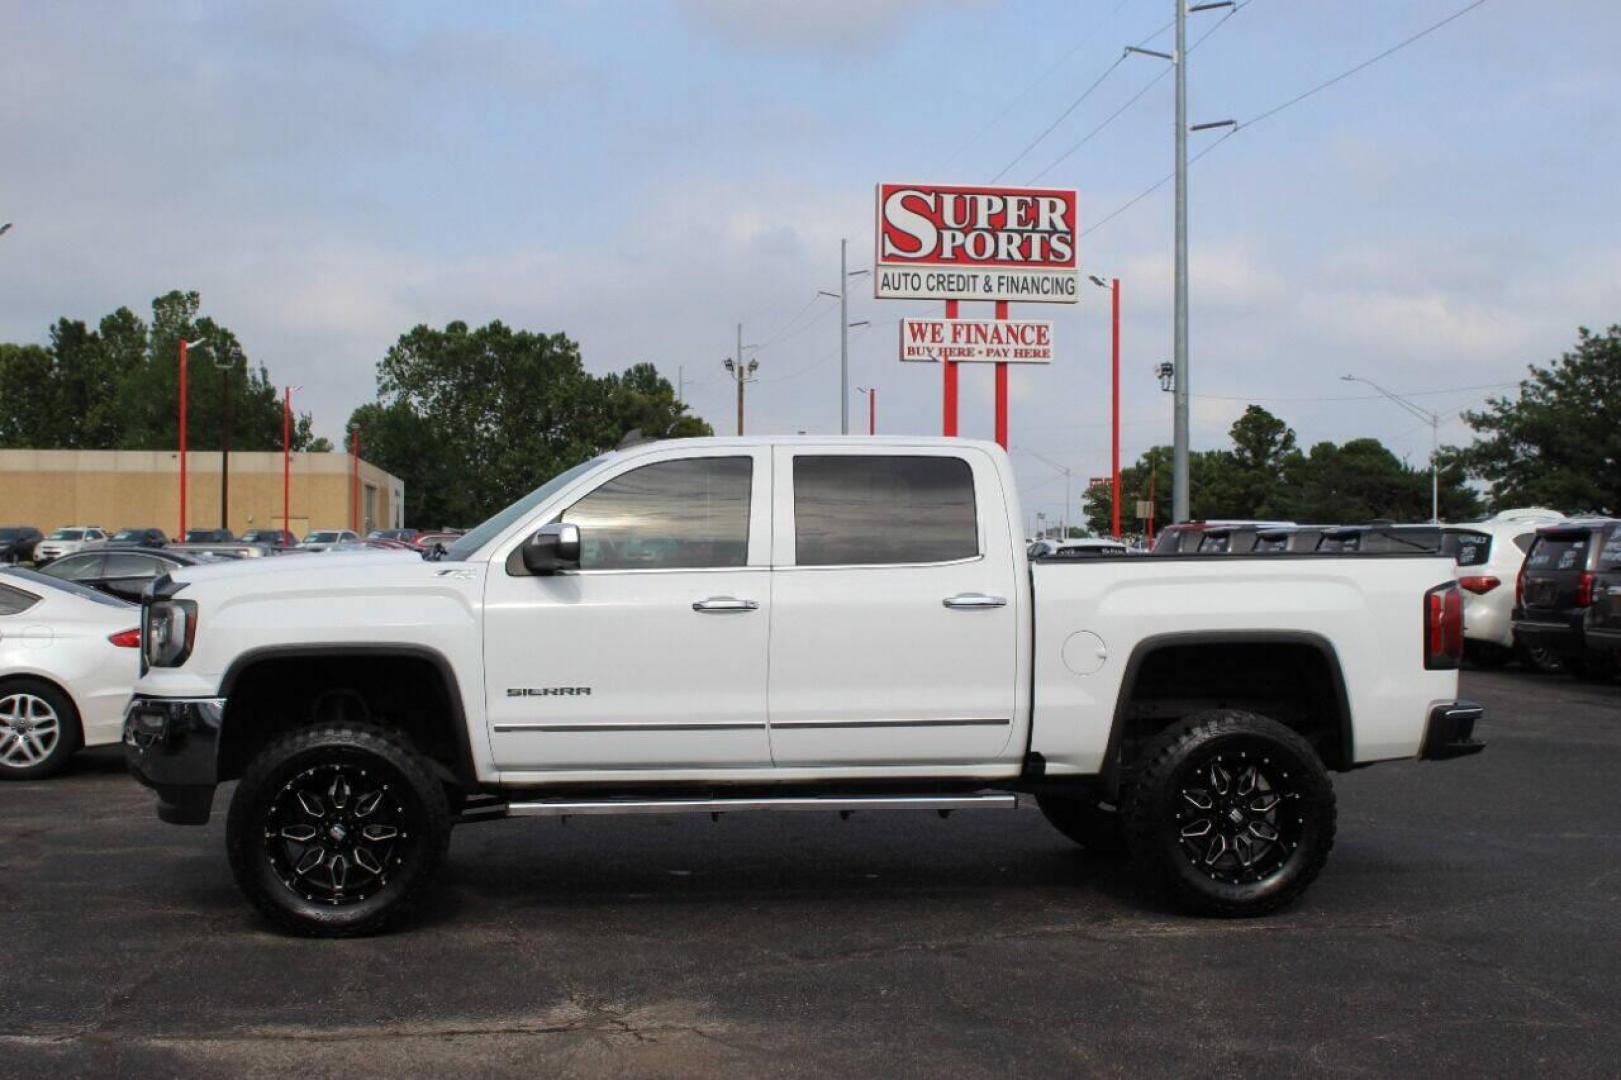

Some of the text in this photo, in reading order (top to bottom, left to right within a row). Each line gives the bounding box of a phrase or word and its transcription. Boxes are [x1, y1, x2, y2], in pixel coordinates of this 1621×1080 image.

[885, 189, 1070, 258] SUPER
[881, 272, 1075, 295] AUTO CREDIT & FINANCING
[908, 322, 1050, 345] WE FINANCE
[907, 347, 1050, 358] BUY HERE PAY HERE
[507, 687, 592, 697] SIERRA
